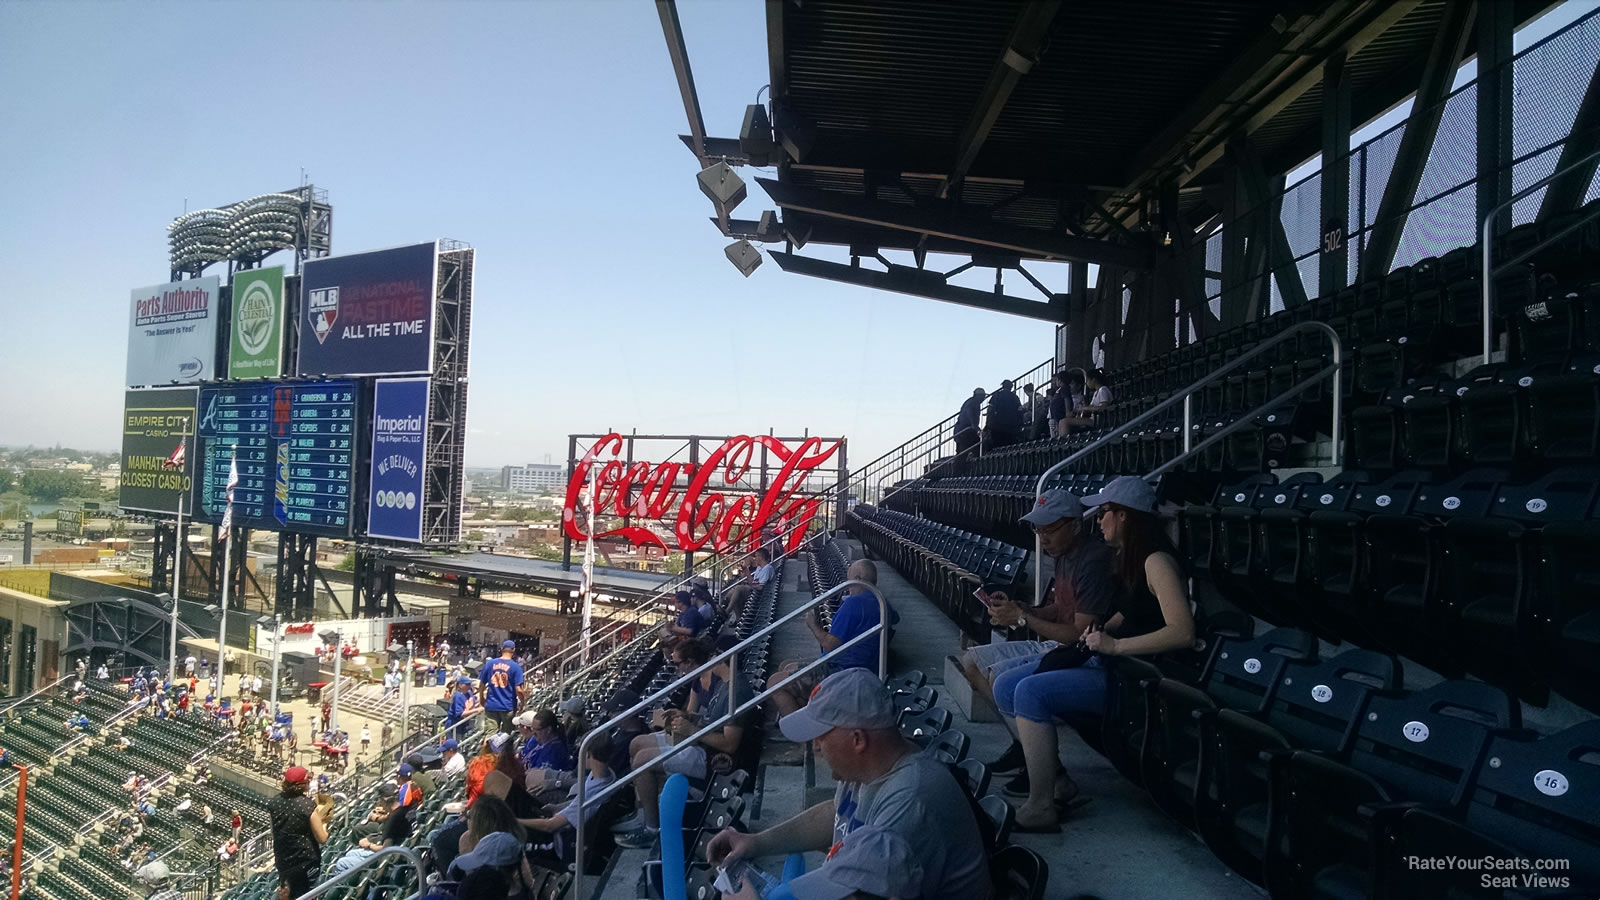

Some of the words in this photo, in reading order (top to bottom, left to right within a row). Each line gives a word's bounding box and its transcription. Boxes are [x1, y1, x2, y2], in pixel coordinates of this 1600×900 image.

[1324, 228, 1341, 253] 502
[136, 295, 161, 317] Parts
[161, 286, 209, 313] Authority
[247, 298, 266, 310] HAIN
[310, 289, 336, 308] MLB
[150, 314, 166, 324] Parts
[166, 312, 185, 322] Super
[185, 310, 207, 320] Stores
[239, 306, 273, 322] CELESTIAL
[156, 327, 175, 336] Answer
[341, 325, 364, 340] ALL
[366, 323, 390, 337] THE
[393, 320, 423, 335] TIME
[128, 416, 164, 427] EMPIRE
[376, 414, 421, 434] Imperial
[145, 429, 168, 438] CASINO
[377, 435, 386, 443] Bag
[390, 435, 402, 443] Paper
[411, 435, 420, 443] LLC
[378, 457, 389, 476] WE
[390, 454, 418, 479] DELIVER
[121, 471, 157, 489] CLOSEST
[275, 441, 290, 514] Mets
[285, 623, 315, 635] Coca-Cola
[1249, 662, 1257, 670] 19
[1317, 689, 1326, 698] 18
[1411, 727, 1421, 737] 17
[1544, 777, 1558, 789] 16
